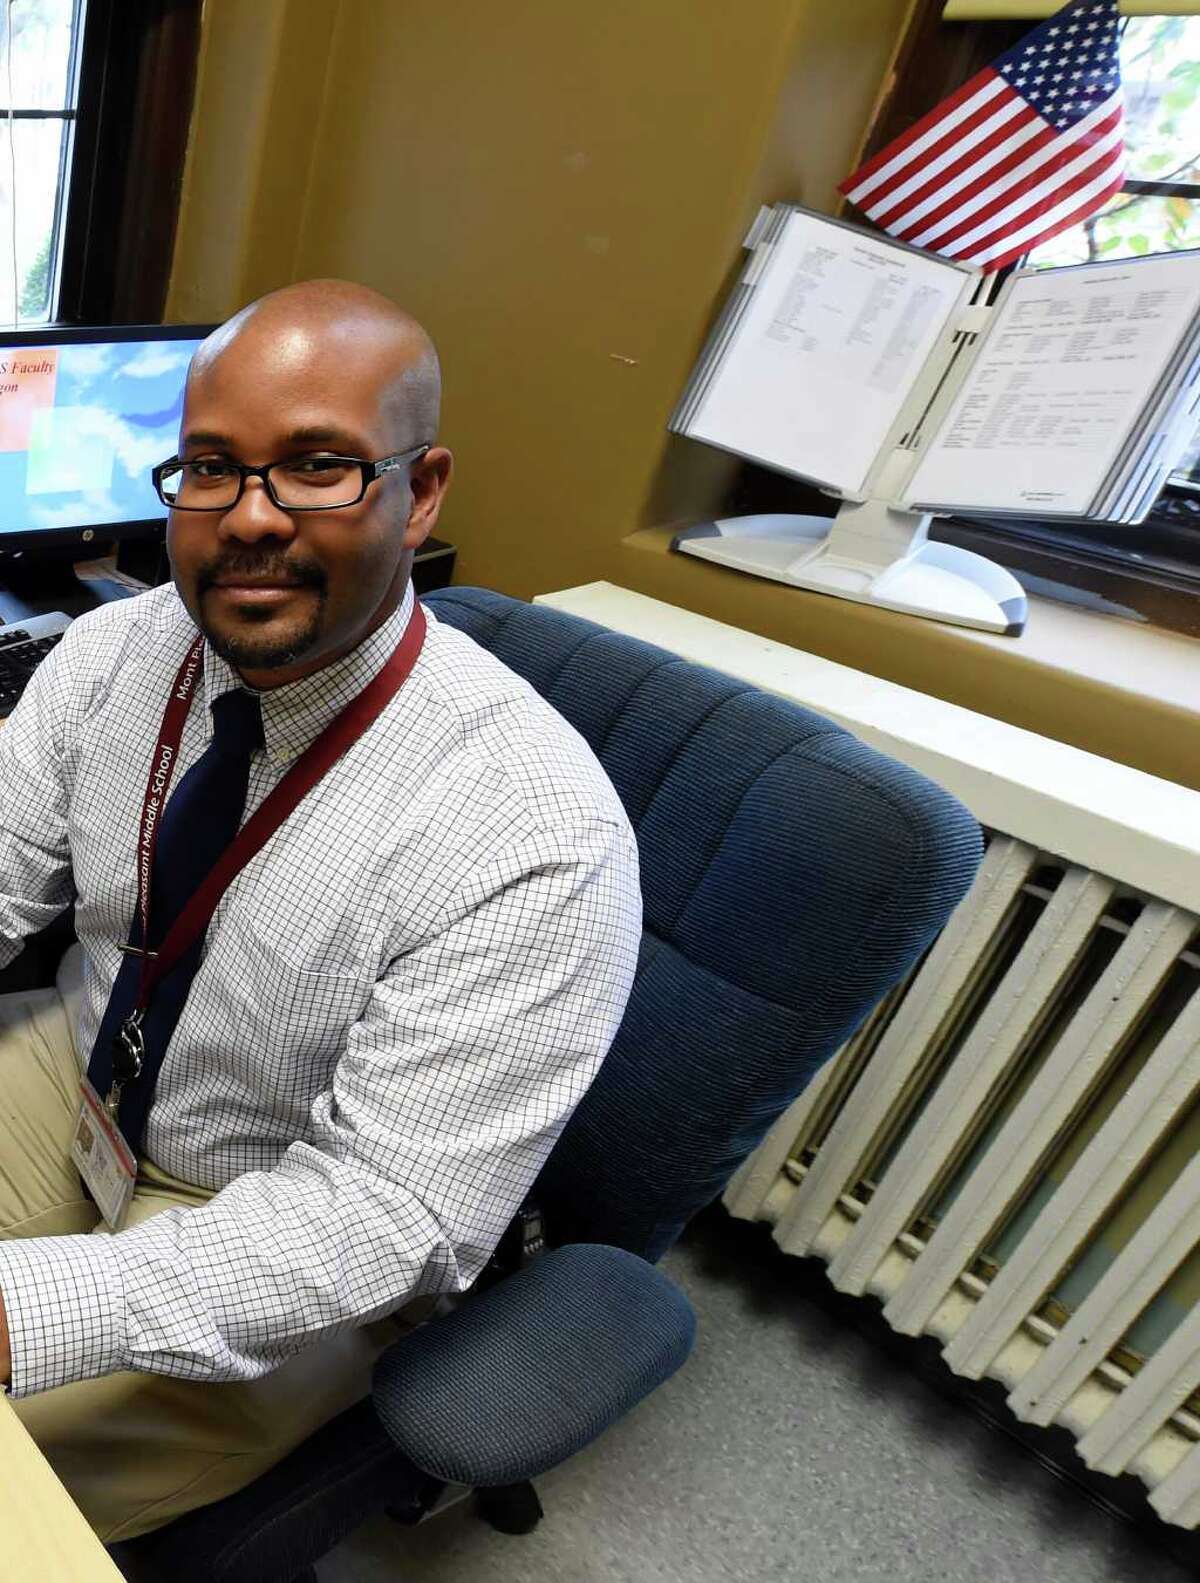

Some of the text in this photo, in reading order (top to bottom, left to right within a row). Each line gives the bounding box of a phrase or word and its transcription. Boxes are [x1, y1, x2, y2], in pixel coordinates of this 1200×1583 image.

[9, 360, 55, 376] Faculty
[177, 663, 198, 700] Mont
[142, 797, 160, 847] Middle
[151, 744, 174, 796] School
